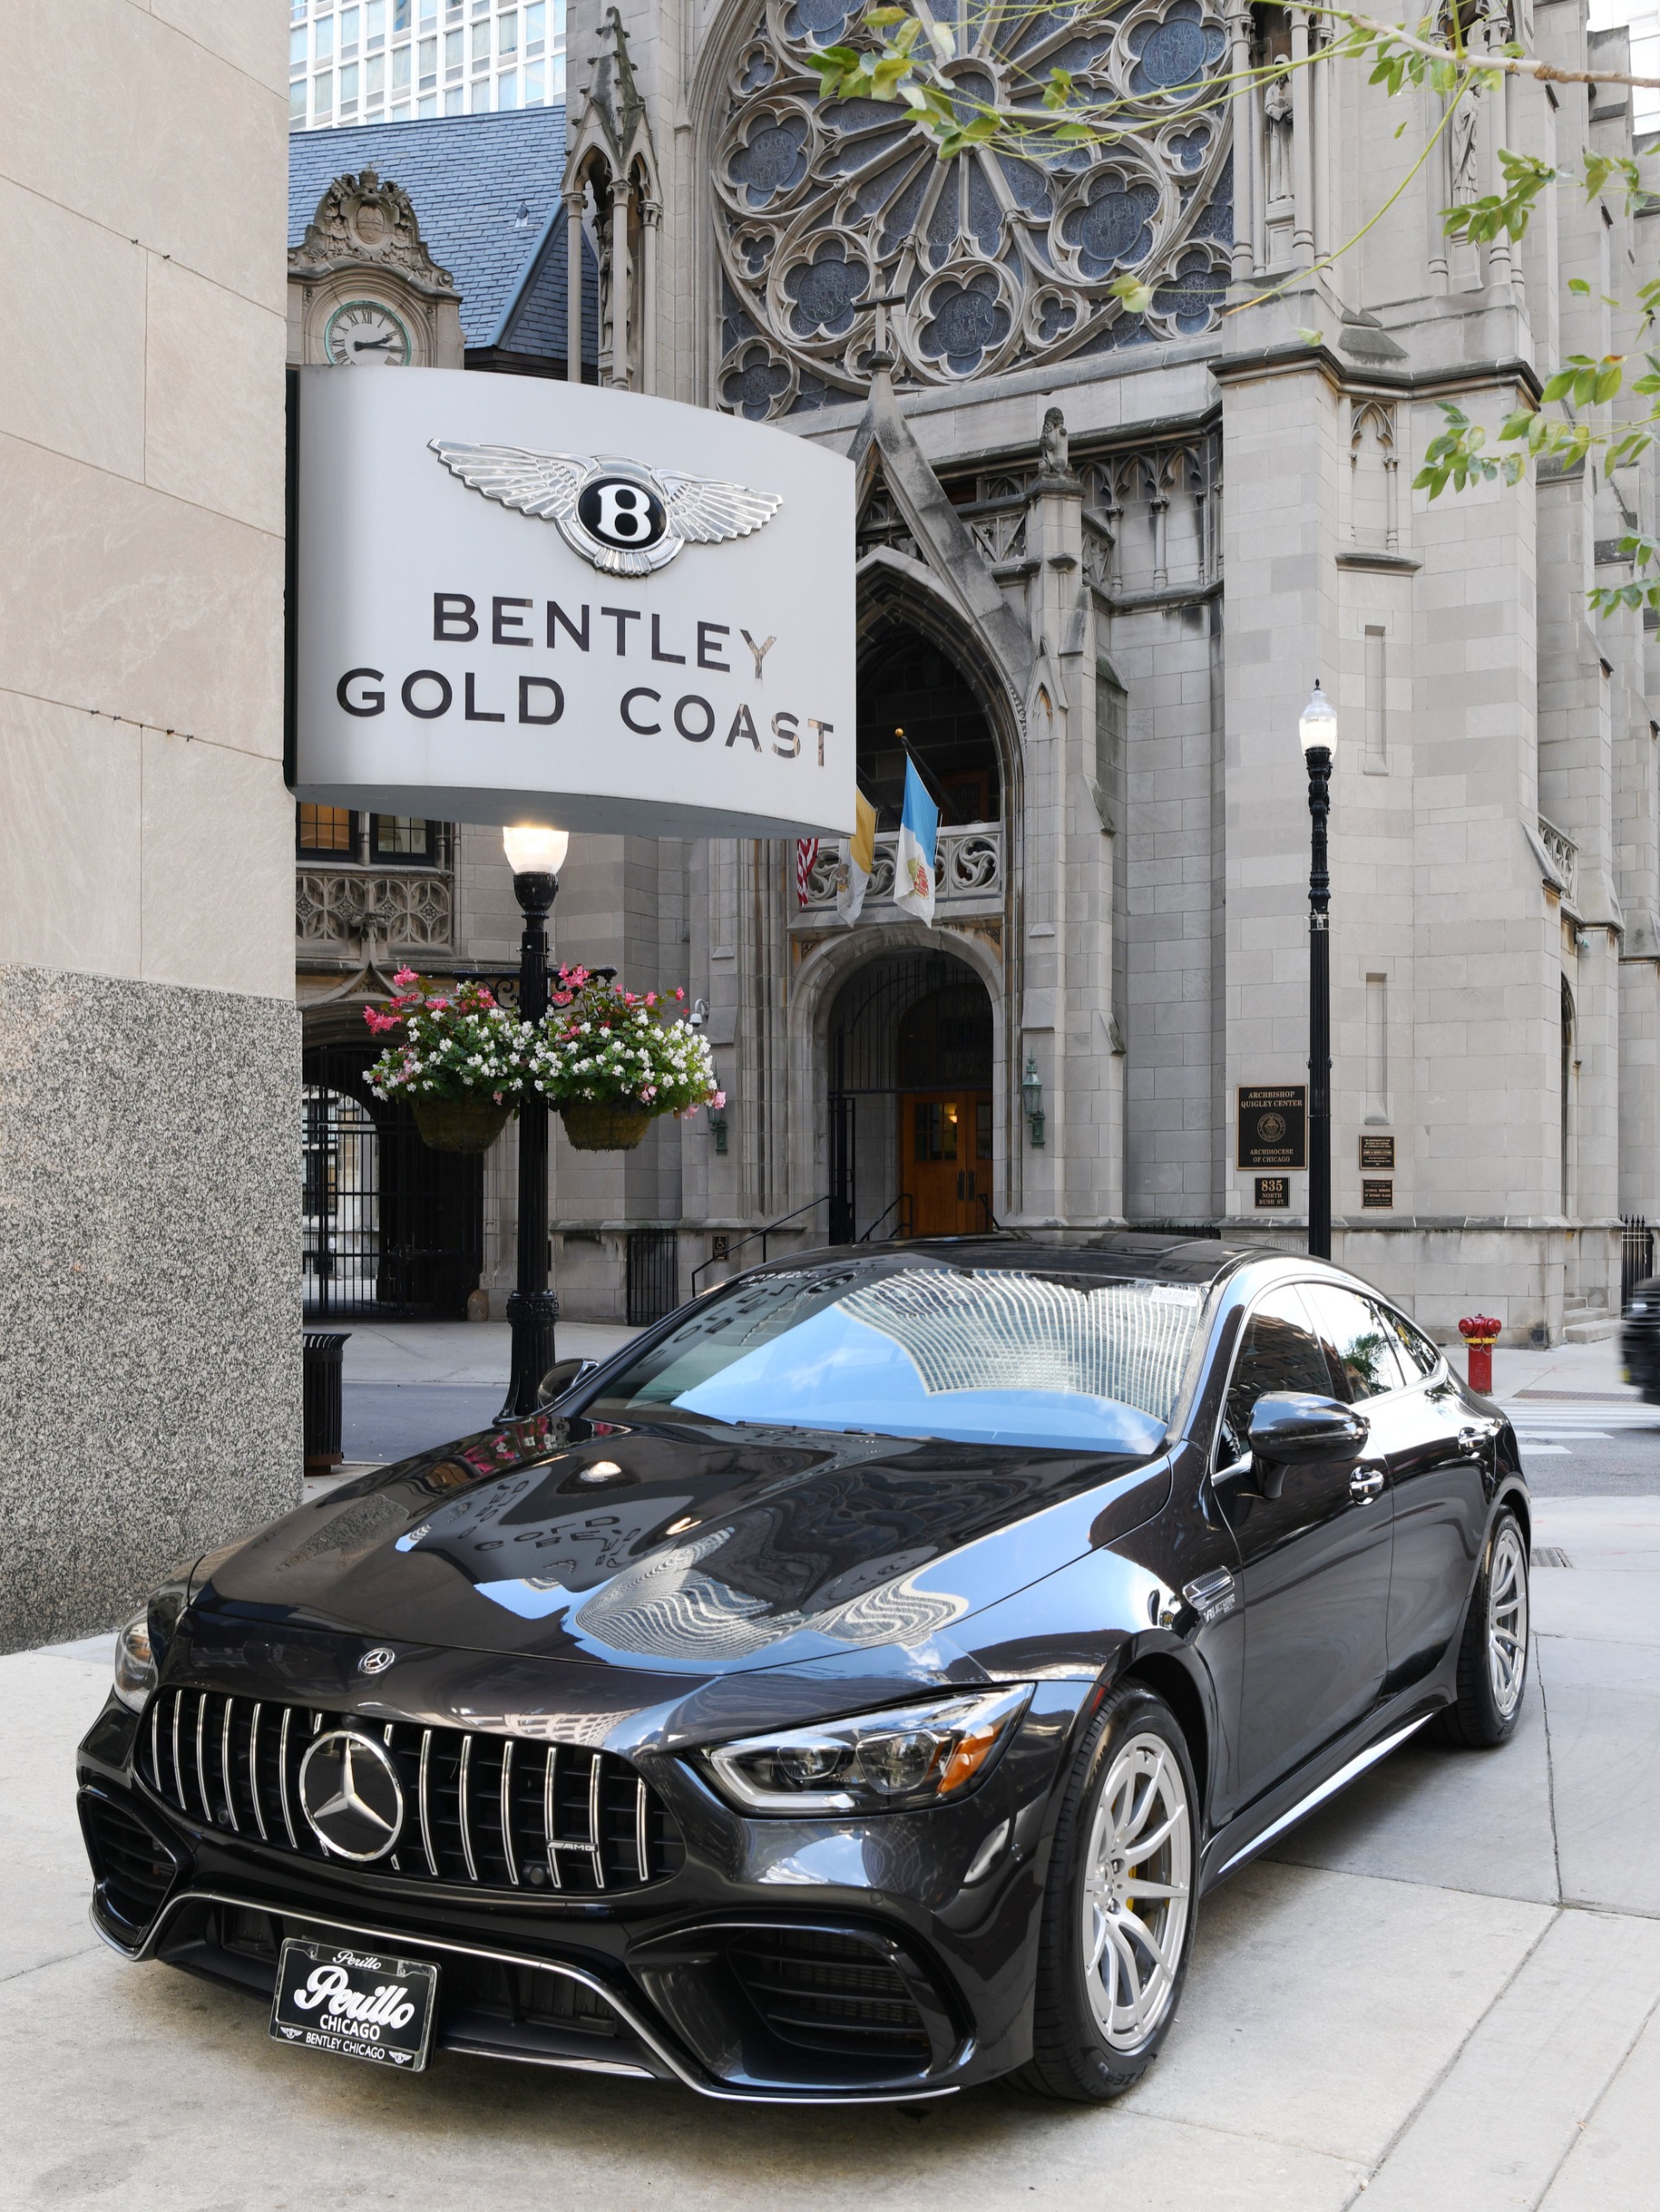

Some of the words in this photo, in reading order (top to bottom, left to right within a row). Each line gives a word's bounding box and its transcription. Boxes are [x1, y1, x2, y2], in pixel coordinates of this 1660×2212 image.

[433, 592, 777, 679] BENTLEY
[336, 667, 565, 725] GOLD
[620, 686, 833, 767] COAST
[1241, 1100, 1273, 1109] QUIGLEY
[1248, 1090, 1295, 1099] ARCHBISHOP
[1261, 1179, 1283, 1191] 835
[562, 1843, 596, 1852] AMG
[332, 1950, 382, 1970] Perillo
[293, 1965, 415, 2029] Perillo
[320, 2014, 380, 2041] CHICAGO
[305, 2031, 342, 2049] BENTLEY
[342, 2039, 386, 2060] CHICAGO
